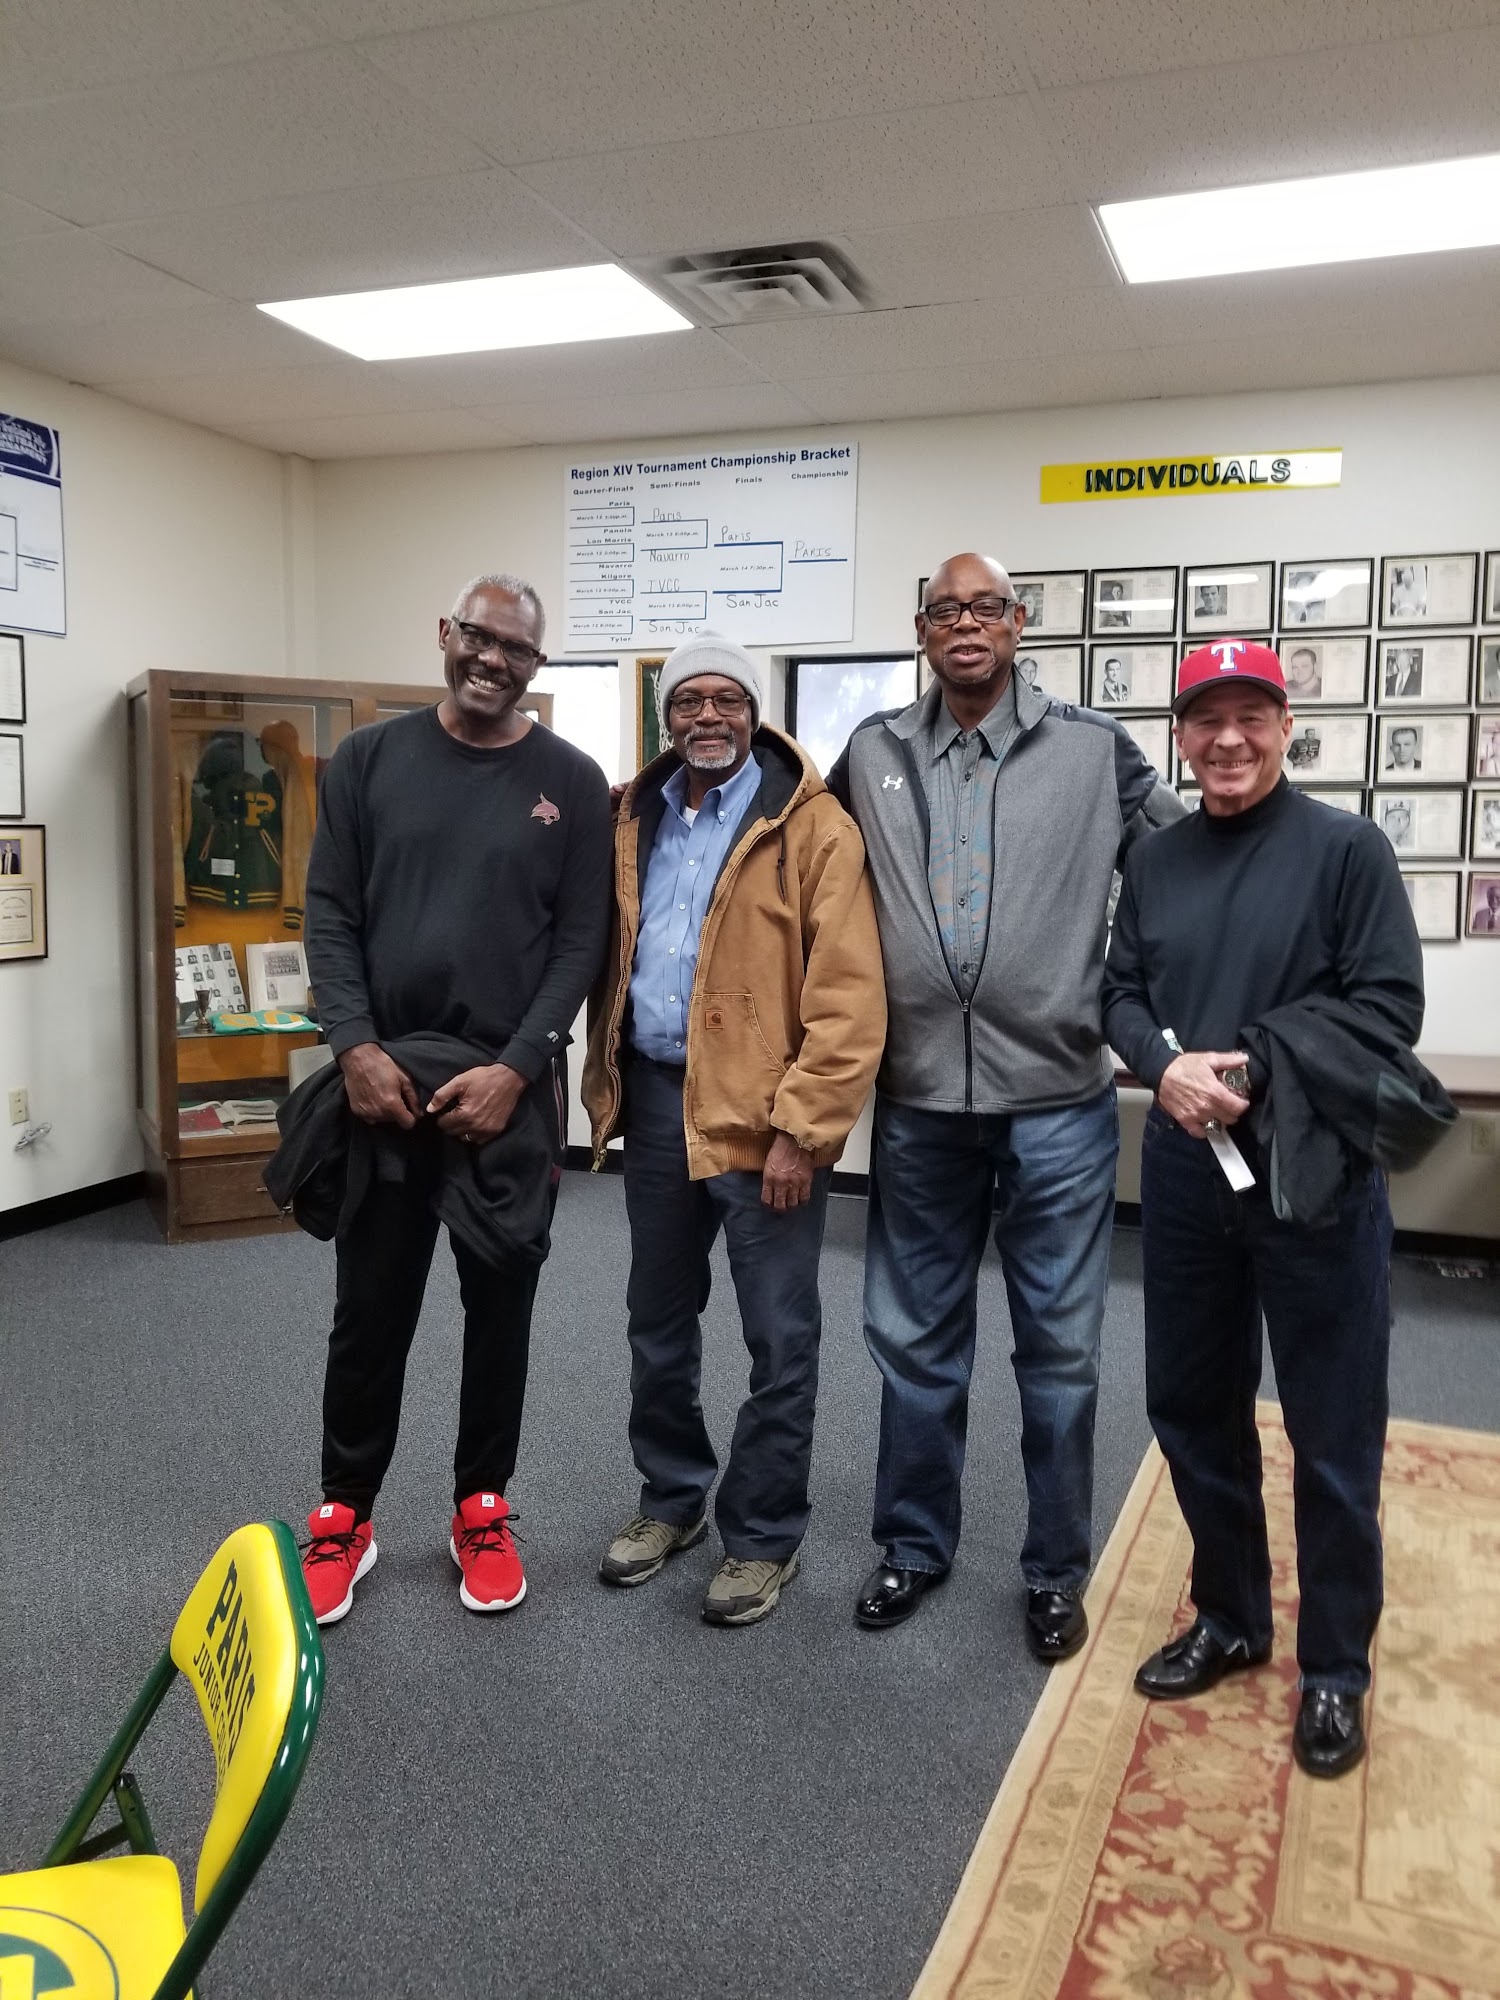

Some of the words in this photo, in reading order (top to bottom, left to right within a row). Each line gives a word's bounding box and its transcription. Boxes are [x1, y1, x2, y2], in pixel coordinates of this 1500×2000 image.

[571, 467, 609, 481] Region
[613, 464, 633, 477] XIV
[636, 459, 707, 474] Tournament
[711, 451, 797, 468] Championship
[800, 446, 850, 461] Bracket
[735, 476, 763, 484] Finals
[791, 470, 849, 480] Championship
[1085, 458, 1291, 493] INDIVIDUALS
[573, 485, 634, 495] Quarter-Finals
[650, 480, 701, 489] Semi-Finals
[652, 507, 682, 522] Paris
[721, 525, 751, 543] Paris
[649, 549, 690, 562] Navarro
[648, 578, 680, 592] TVCC
[726, 594, 751, 608] San
[754, 593, 779, 608] Jac
[648, 620, 672, 633] San
[674, 621, 700, 634] Jac
[1210, 641, 1246, 672] T
[244, 791, 276, 826] P
